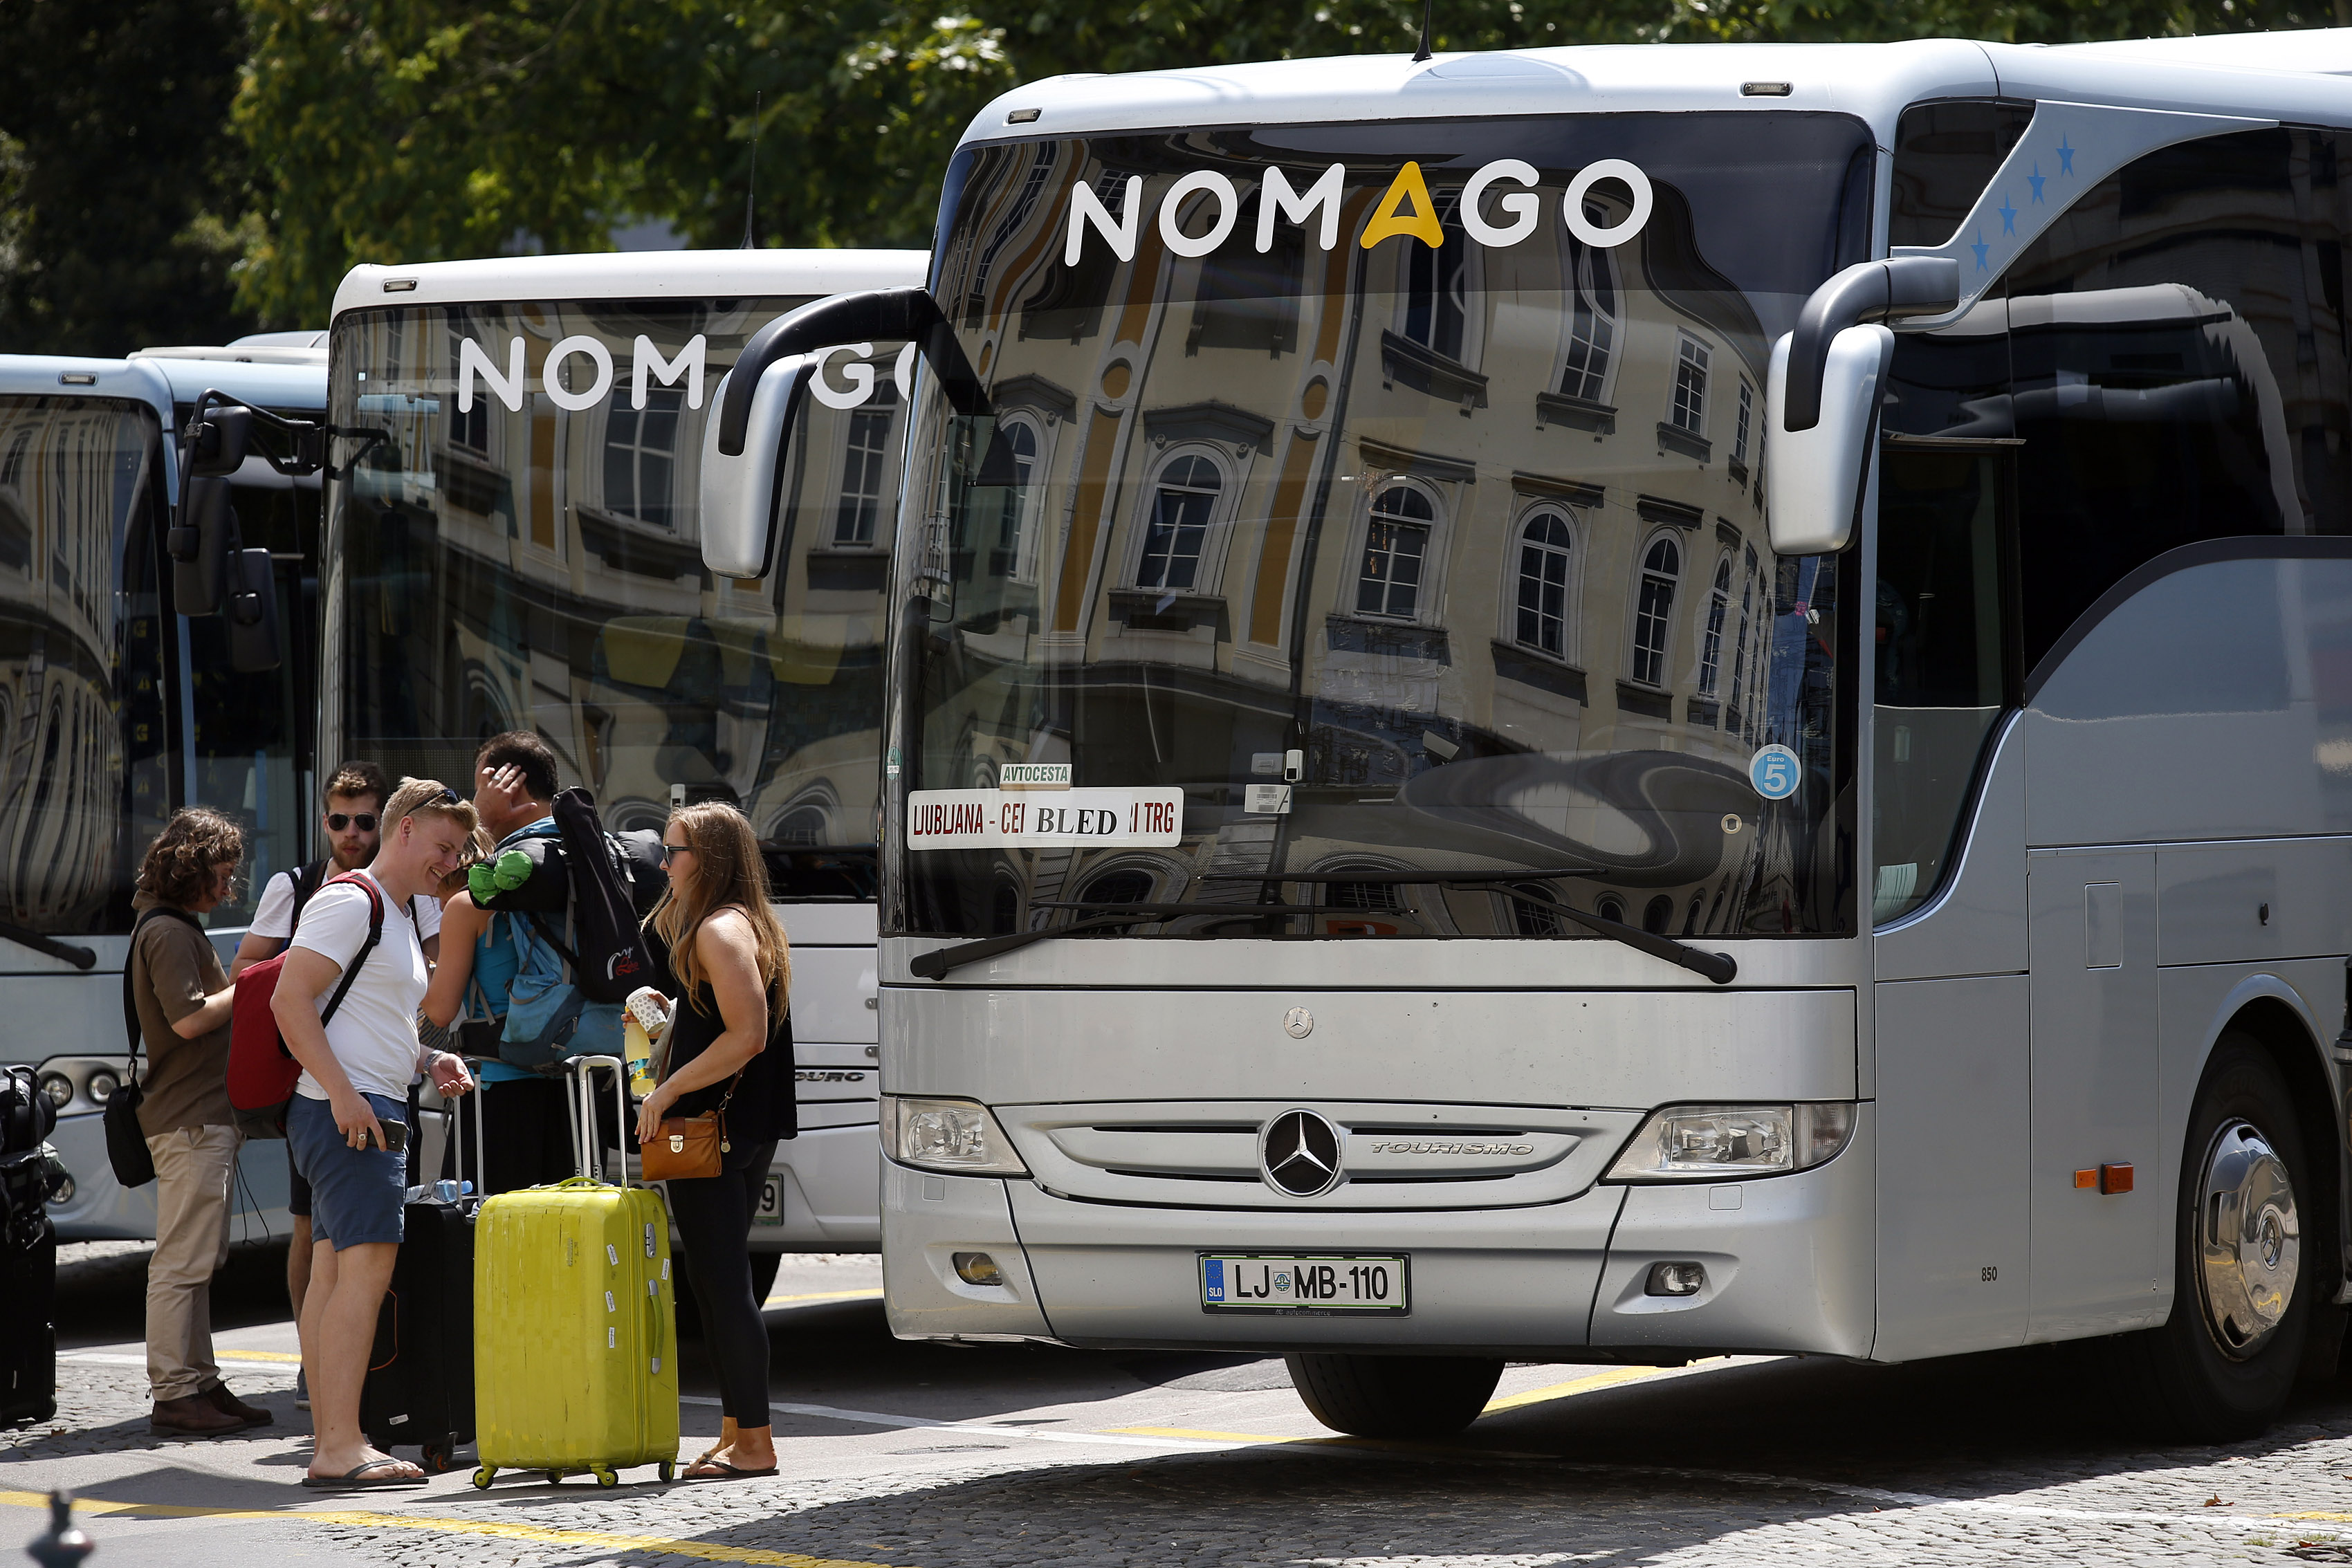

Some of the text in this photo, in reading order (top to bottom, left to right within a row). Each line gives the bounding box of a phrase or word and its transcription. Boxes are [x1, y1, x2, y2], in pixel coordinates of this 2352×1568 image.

[1064, 158, 1653, 267] NOMAGO
[458, 333, 917, 414] NOMG
[1002, 766, 1068, 782] AVTOCESTA
[1763, 764, 1787, 793] 5
[913, 803, 984, 836] LJUBLJANA
[1144, 801, 1175, 834] TRG
[1035, 807, 1118, 836] BLED
[1370, 1141, 1534, 1156] TOURISMO
[1235, 1264, 1388, 1300] LJ MB-110
[1982, 1266, 1997, 1282] 850
[1209, 1287, 1222, 1298] SLO
